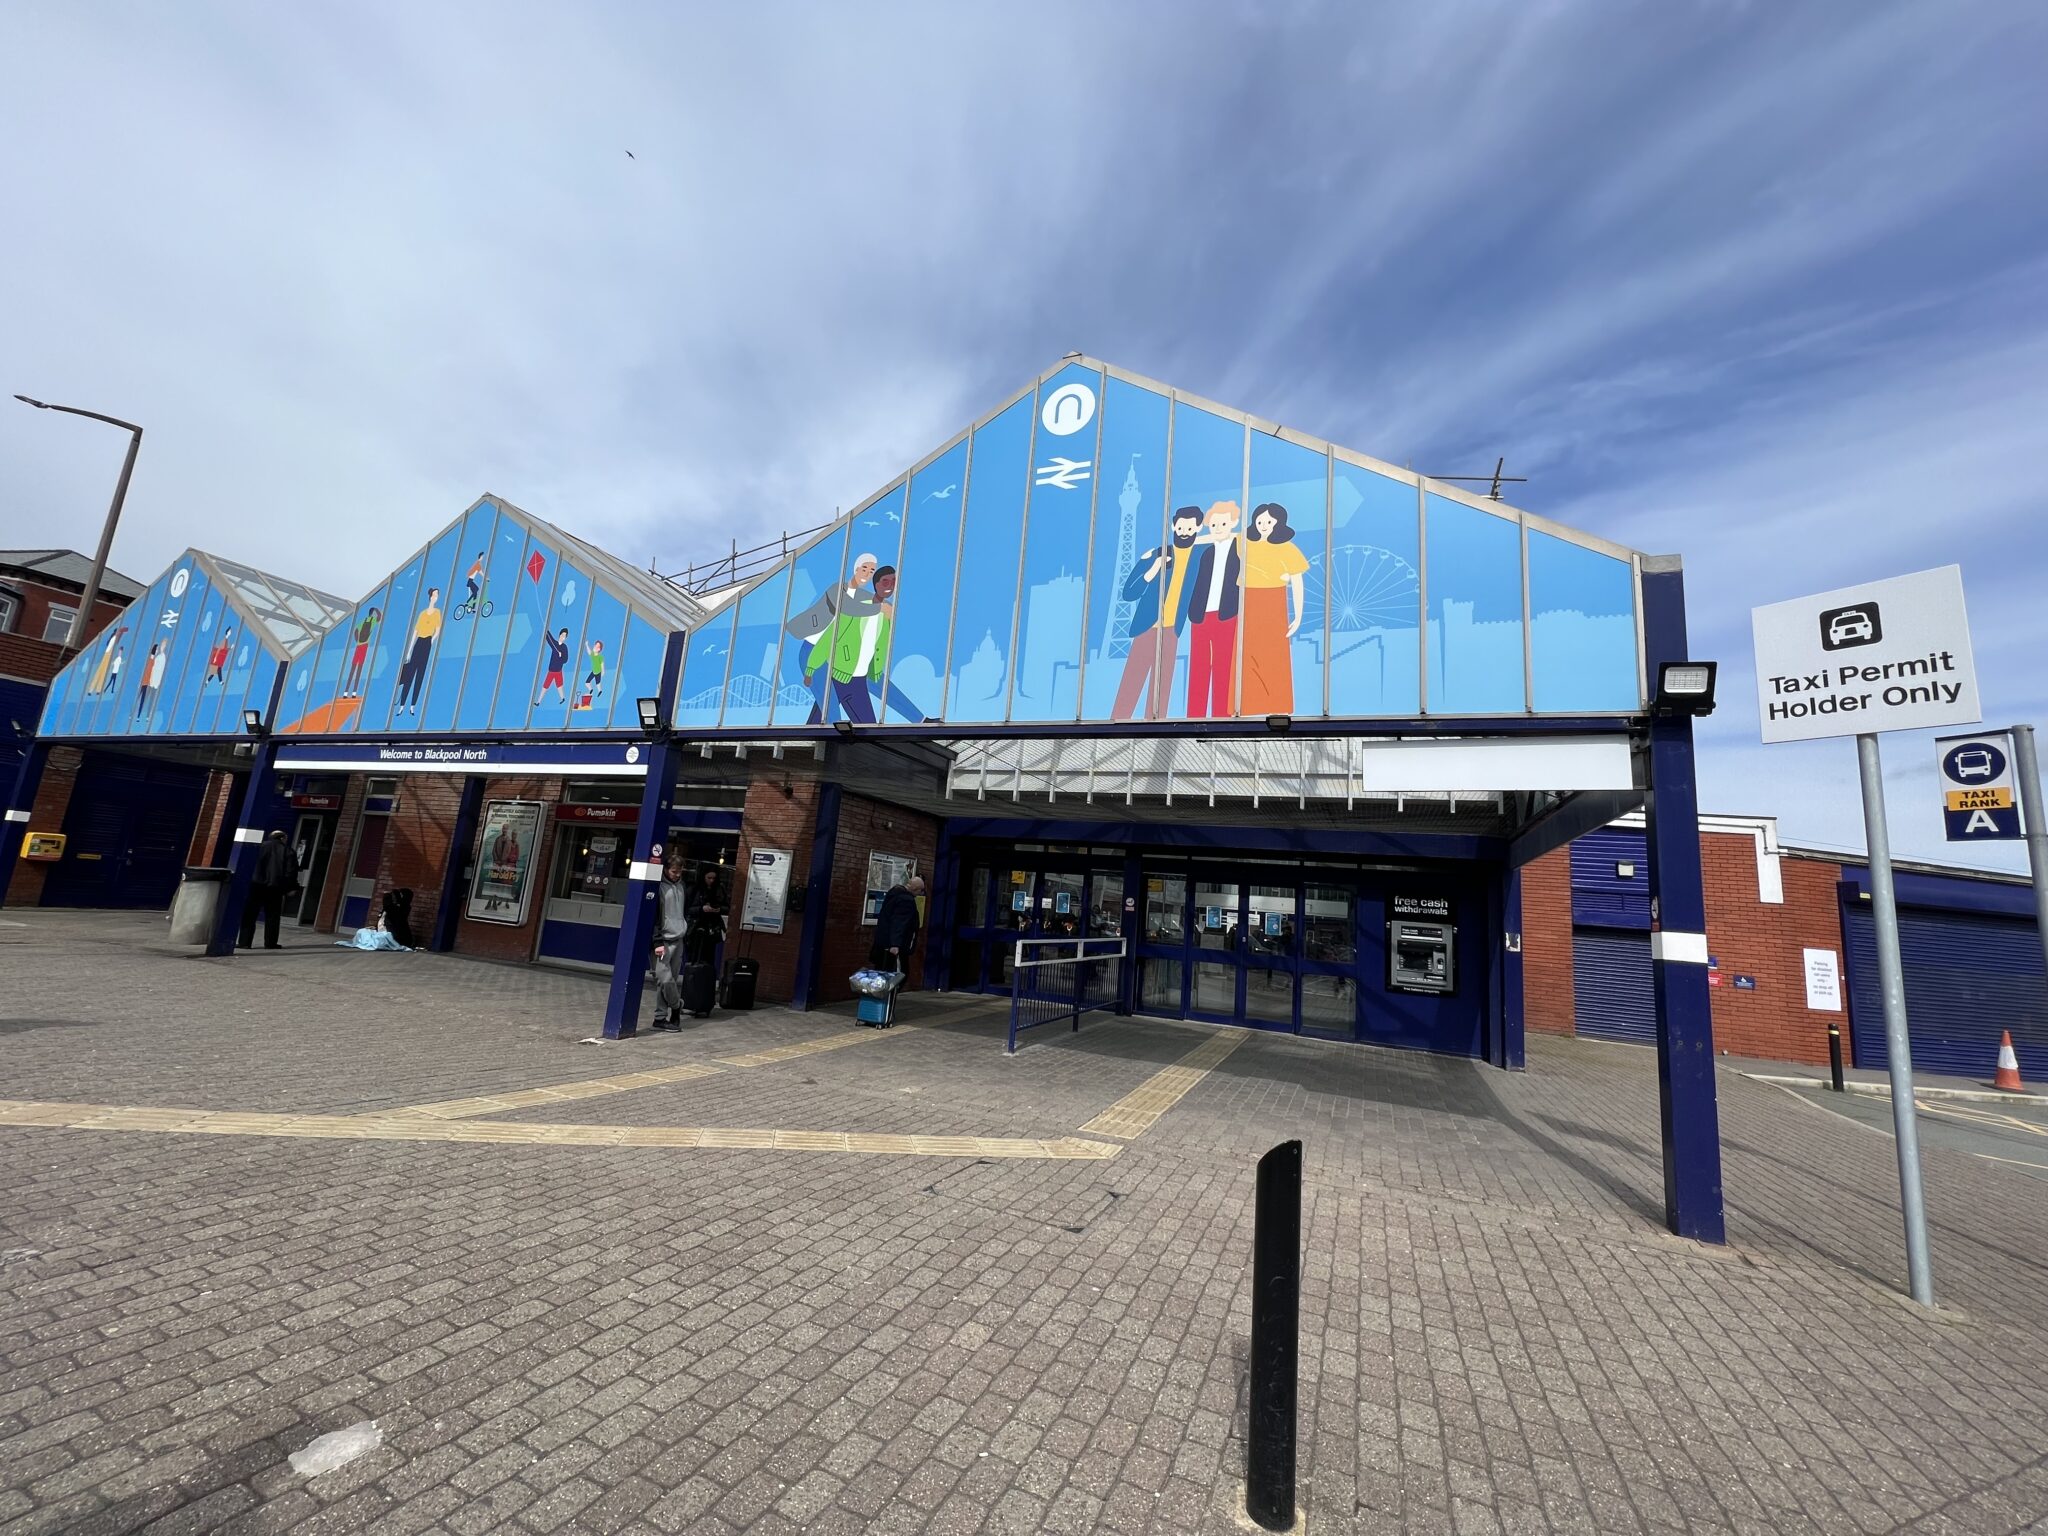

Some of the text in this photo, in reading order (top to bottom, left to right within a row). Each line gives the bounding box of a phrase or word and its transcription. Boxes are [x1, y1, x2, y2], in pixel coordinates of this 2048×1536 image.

[1769, 651, 1955, 695] Taxi Permit
[1769, 681, 1962, 721] Holder Only
[380, 749, 487, 762] Welcome to Blackpool North
[1961, 789, 1996, 800] TAXI
[1959, 798, 2001, 808] RANK
[587, 807, 616, 817] Pumpkin
[1965, 809, 2000, 833] A
[1394, 895, 1448, 908] free cash
[1394, 904, 1448, 916] withdrawals
